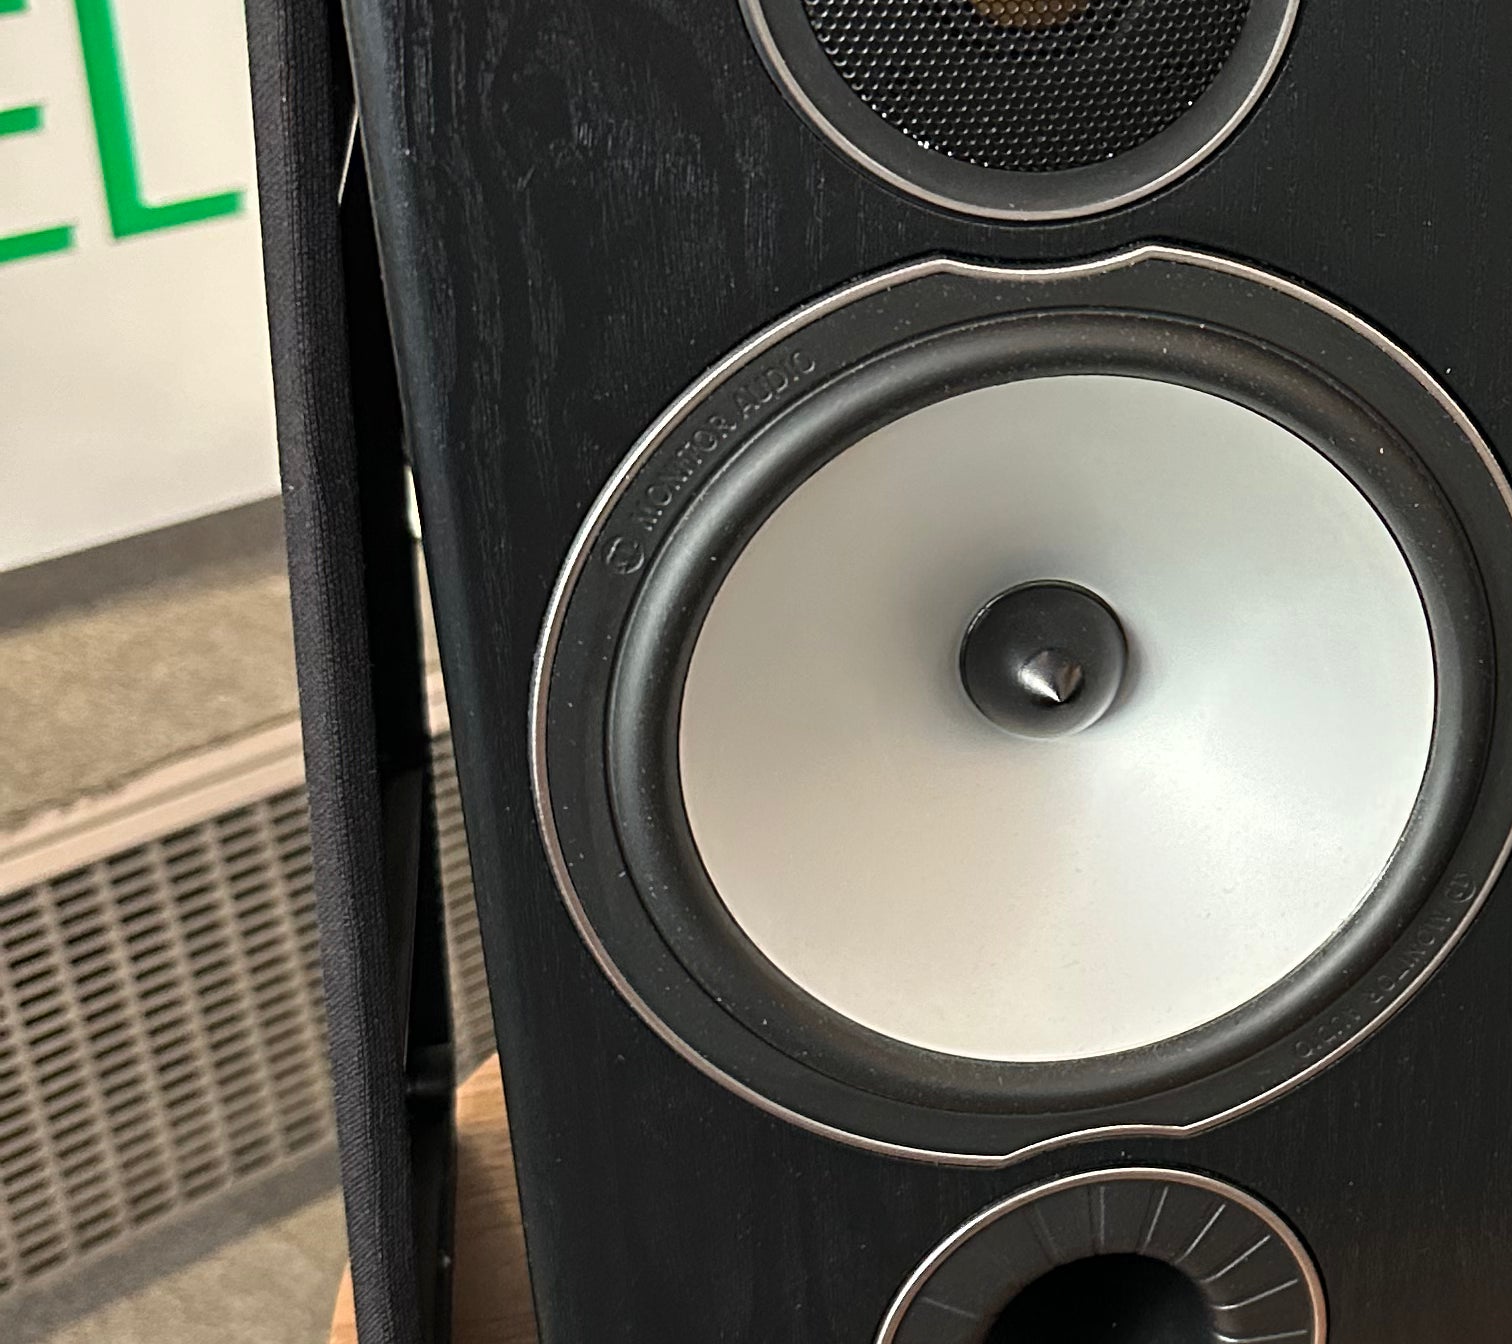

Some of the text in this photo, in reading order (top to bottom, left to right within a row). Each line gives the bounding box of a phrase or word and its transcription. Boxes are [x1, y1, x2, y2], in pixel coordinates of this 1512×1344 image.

[632, 351, 817, 530] MONITOR AUDIO
[1360, 909, 1453, 1004] MONITOR
